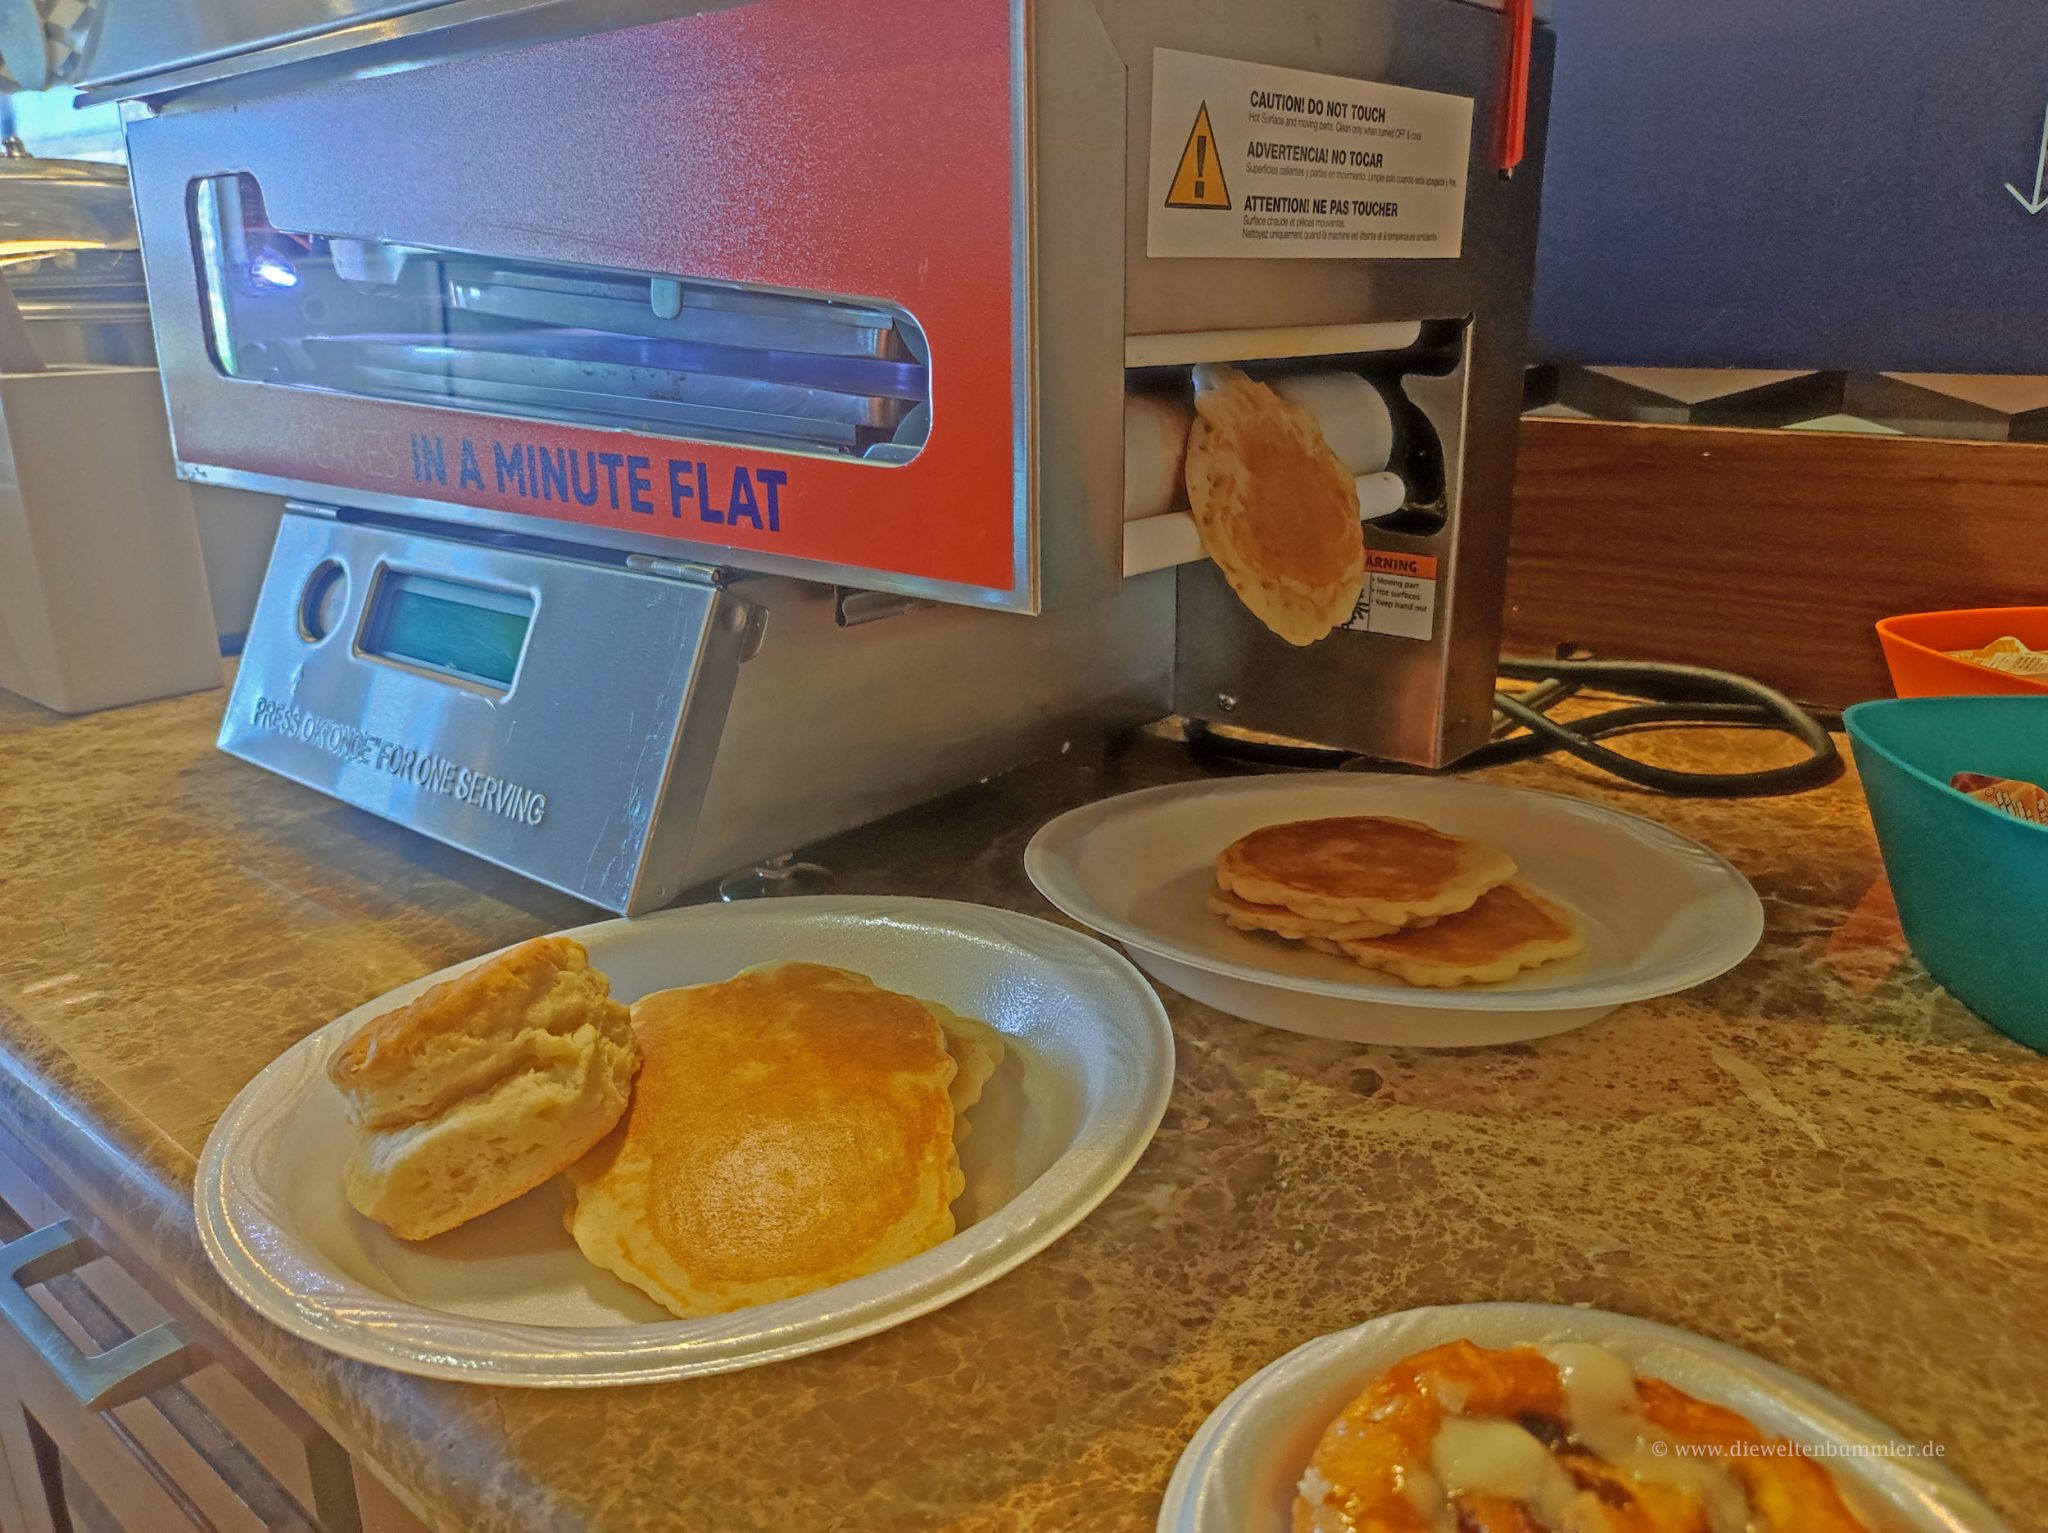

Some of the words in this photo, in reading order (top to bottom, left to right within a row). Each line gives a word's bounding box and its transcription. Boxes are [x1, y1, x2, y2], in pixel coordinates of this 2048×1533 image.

[1250, 90, 1305, 113] CAUTION!
[1308, 98, 1323, 115] DO
[1327, 101, 1348, 118] NOT
[1352, 104, 1386, 123] TOUCH
[1248, 112, 1260, 122] Hot
[1261, 113, 1284, 126] Surface
[1286, 117, 1296, 128] and
[1298, 119, 1318, 132] moving
[1247, 141, 1328, 164] ADVERTENCIA!
[1331, 149, 1346, 165] NO
[1350, 151, 1383, 168] TOCAR
[1244, 195, 1309, 214] ATTENTION!
[1312, 199, 1327, 214] NE
[1330, 199, 1349, 215] PAS
[1352, 201, 1398, 217] TOUCHER
[411, 432, 447, 486] IN
[460, 438, 485, 492] A
[494, 442, 654, 514] MINUTE
[668, 459, 787, 532] FLAT
[1365, 555, 1417, 573] ARNING
[253, 696, 300, 738] PRESS
[301, 715, 327, 748] OK
[376, 740, 417, 782] FOR
[415, 754, 459, 796] ONE
[455, 767, 548, 826] SERVING
